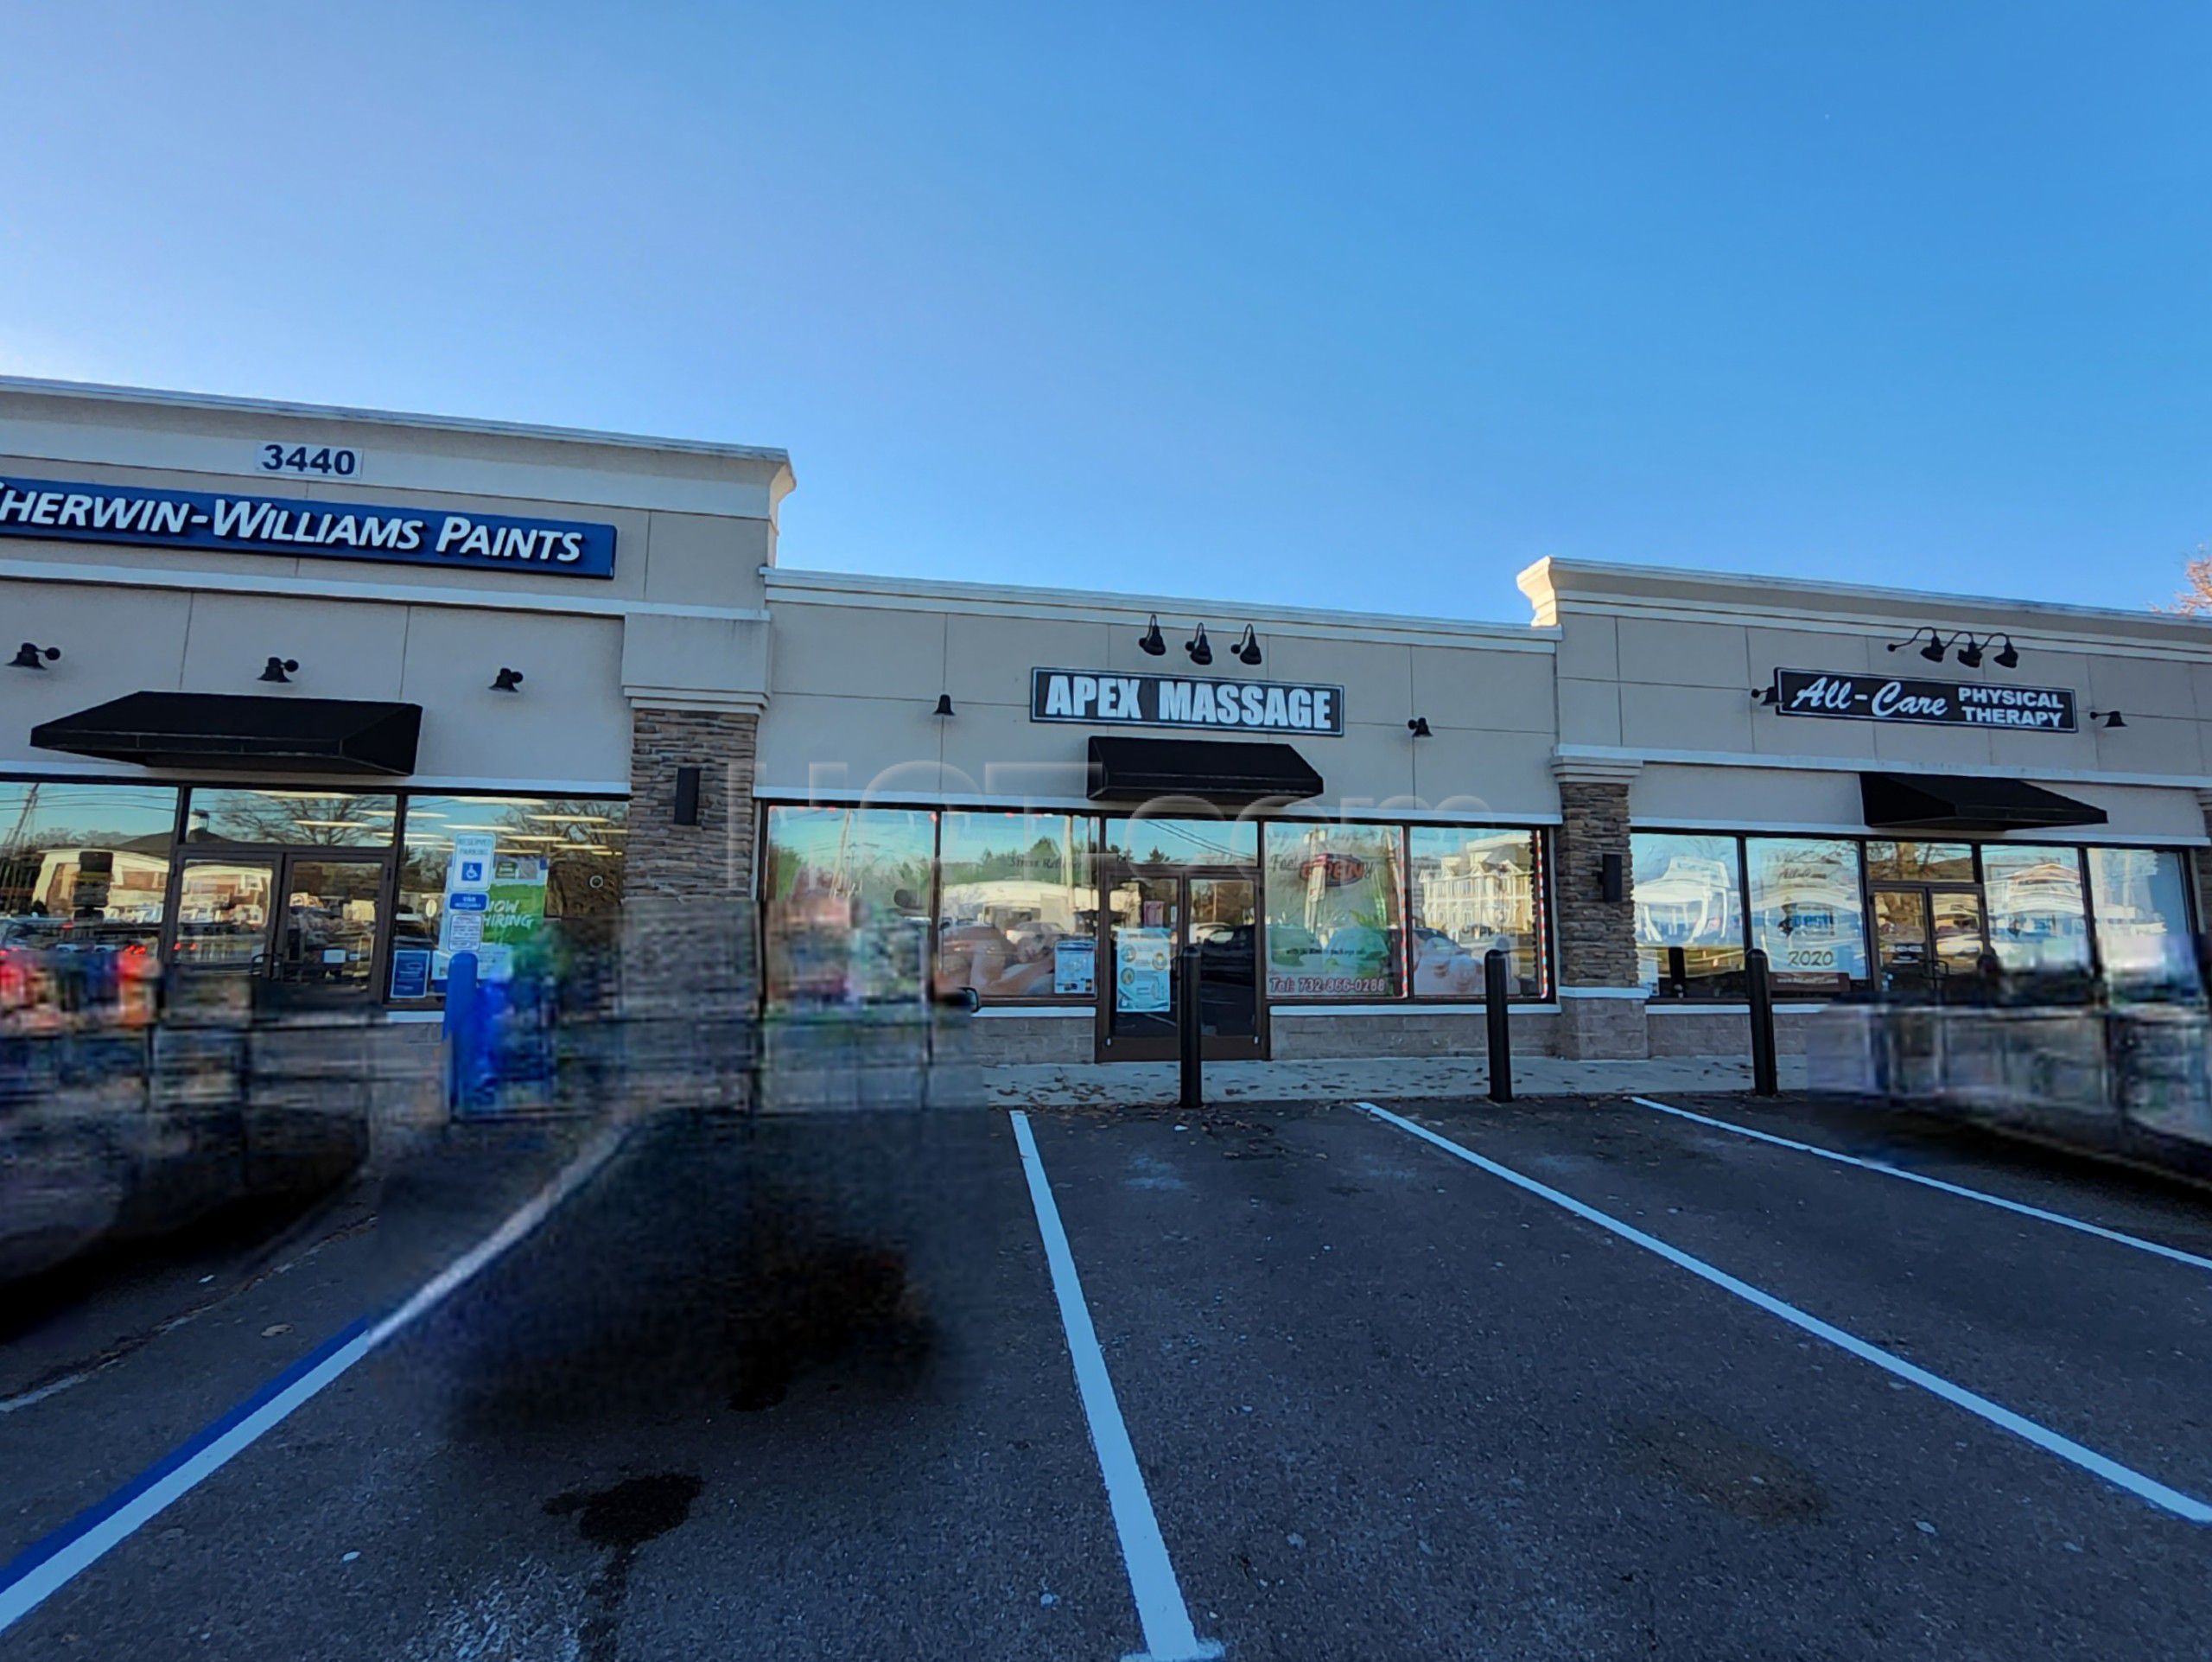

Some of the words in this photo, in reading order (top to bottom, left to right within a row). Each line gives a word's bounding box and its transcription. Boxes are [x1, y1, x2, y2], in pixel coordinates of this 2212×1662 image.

[261, 444, 356, 475] 3440
[0, 481, 421, 551] HERWIN-WILLIAMS
[435, 516, 584, 563] PAINTS
[1045, 674, 1142, 719] APEX
[1158, 680, 1332, 729] MASSAGE
[1790, 676, 1948, 717] All-Care
[1958, 686, 2065, 709] PHYSICAL
[1961, 705, 2063, 728] THERAPY
[482, 913, 534, 930] HIRING
[1788, 950, 1834, 966] 2020
